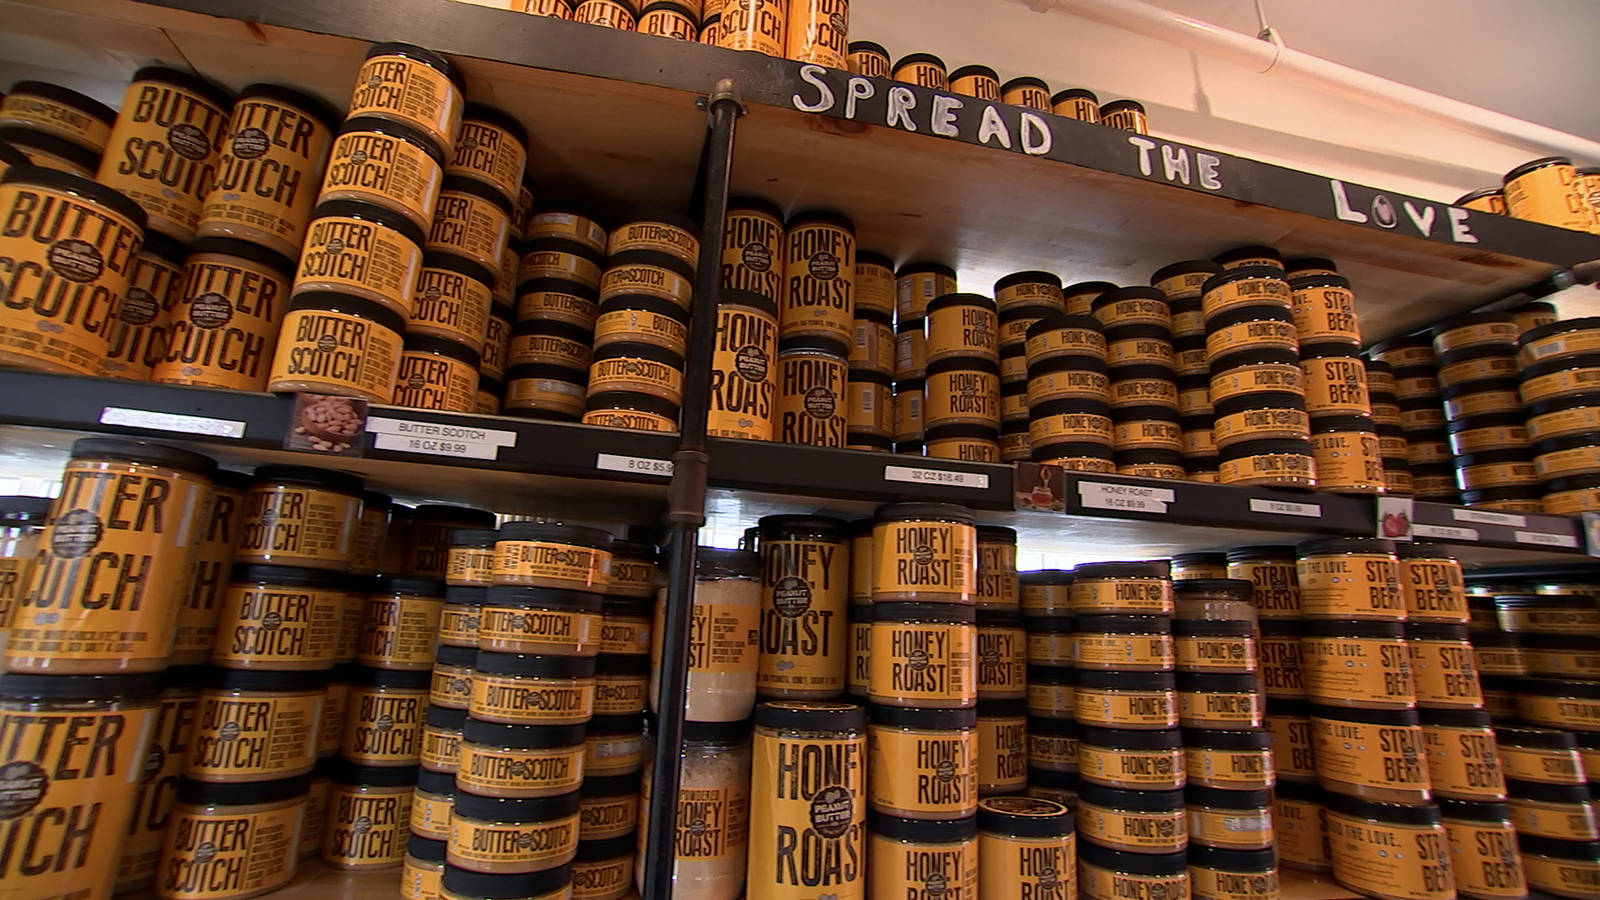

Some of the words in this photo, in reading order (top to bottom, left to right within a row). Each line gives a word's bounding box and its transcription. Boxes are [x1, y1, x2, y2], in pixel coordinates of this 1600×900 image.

[721, 2, 781, 44] SCOTCH
[361, 61, 405, 85] BUTTER
[351, 86, 401, 111] SCOTCH
[335, 135, 394, 164] BUTTER
[793, 64, 1053, 156] SPREAD
[1128, 136, 1222, 191] THE
[1330, 179, 1480, 244] LOVE
[327, 163, 388, 192] SCOTCH
[310, 221, 372, 252] BUTTER
[628, 226, 661, 240] BUTTER
[726, 217, 784, 256] HONEY
[790, 229, 852, 267] HONEY
[301, 246, 367, 280] SCOTCH
[810, 260, 837, 268] PEANUT
[810, 265, 837, 273] BUTTER
[628, 270, 664, 286] SCOTCH
[1237, 281, 1267, 297] HONEY
[789, 275, 852, 313] ROAST
[1016, 284, 1042, 295] HONEY
[962, 309, 995, 327] HONEY
[1115, 300, 1144, 316] HONEY
[295, 315, 366, 351] BUTTER
[715, 310, 779, 365] HONEY
[963, 329, 996, 350] ROAST
[1061, 331, 1089, 344] HONEY
[1247, 323, 1276, 337] HONEY
[529, 337, 561, 353] BUTTER
[1136, 341, 1162, 357] HONEY
[287, 347, 360, 382] SCOTCH
[738, 355, 766, 365] PEANUT
[738, 362, 766, 372] BUTTER
[597, 360, 628, 377] BUTTER
[635, 364, 670, 383] SCOTCH
[783, 359, 847, 402] HONEY
[1067, 372, 1096, 387] HONEY
[1254, 370, 1284, 385] HONEY
[950, 374, 987, 393] HONEY
[1117, 383, 1144, 397] HONEY
[709, 369, 776, 421] ROAST
[951, 394, 988, 415] ROAST
[1062, 415, 1092, 430] HONEY
[1244, 410, 1275, 426] HONEY
[398, 422, 440, 436] BUTTER
[441, 427, 486, 440] SCOTCH
[782, 411, 846, 449] ROAST
[1141, 423, 1168, 438] HONEY
[409, 439, 420, 449] 16
[422, 441, 438, 451] OZ
[439, 443, 467, 454] $9.99
[959, 444, 995, 462] HONEY
[627, 460, 635, 469] 8
[637, 461, 652, 471] OZ
[1253, 457, 1285, 472] HONEY
[923, 471, 937, 481] OZ
[1101, 485, 1126, 497] HONEY
[1128, 488, 1154, 498] ROAST
[897, 527, 950, 555] HONEY
[521, 545, 557, 565] BUTTER
[564, 549, 600, 570] SCOTCH
[1306, 561, 1322, 574] THE
[897, 558, 950, 586] ROAST
[776, 589, 808, 598] PEANUT
[776, 597, 809, 606] BUTTER
[1115, 583, 1150, 601] HONEY
[240, 591, 309, 622] BUTTER
[523, 615, 571, 636] SCOTCH
[233, 625, 306, 656] SCOTCH
[892, 630, 946, 660] HONEY
[1197, 641, 1232, 660] HONEY
[892, 662, 946, 693] ROAST
[486, 685, 528, 707] BUTTER
[539, 688, 583, 712] SCOTCH
[1129, 697, 1162, 716] HONEY
[1206, 695, 1241, 714] HONEY
[202, 701, 270, 732] BUTTER
[360, 695, 417, 725] BUTTER
[353, 726, 414, 755] SCOTCH
[194, 735, 266, 769] SCOTCH
[917, 740, 968, 769] HONEY
[471, 753, 511, 777] BUTTER
[523, 757, 570, 781] SCOTCH
[777, 742, 866, 801] HONEY
[1121, 755, 1157, 775] HONEY
[680, 789, 720, 798] POWDERED
[917, 774, 968, 805] ROAST
[337, 795, 396, 825] BUTTER
[590, 801, 629, 826] SCOTCH
[676, 801, 722, 829] HONEY
[814, 803, 850, 814] PEANUT
[814, 813, 851, 823] BUTTER
[175, 817, 249, 851] BUTTER
[472, 827, 518, 853] BUTTER
[529, 823, 573, 852] SCOTCH
[1123, 817, 1159, 838] HONEY
[1345, 824, 1366, 842] THE
[331, 829, 393, 859] SCOTCH
[674, 829, 721, 857] ROAST
[776, 818, 866, 887] ROAST
[906, 851, 962, 882] HONEY
[1020, 847, 1070, 877] HONEY
[164, 856, 243, 892] SCOTCH
[585, 863, 624, 890] SCOTCH
[1216, 873, 1252, 894] HONEY
[1113, 877, 1150, 899] HONEY
